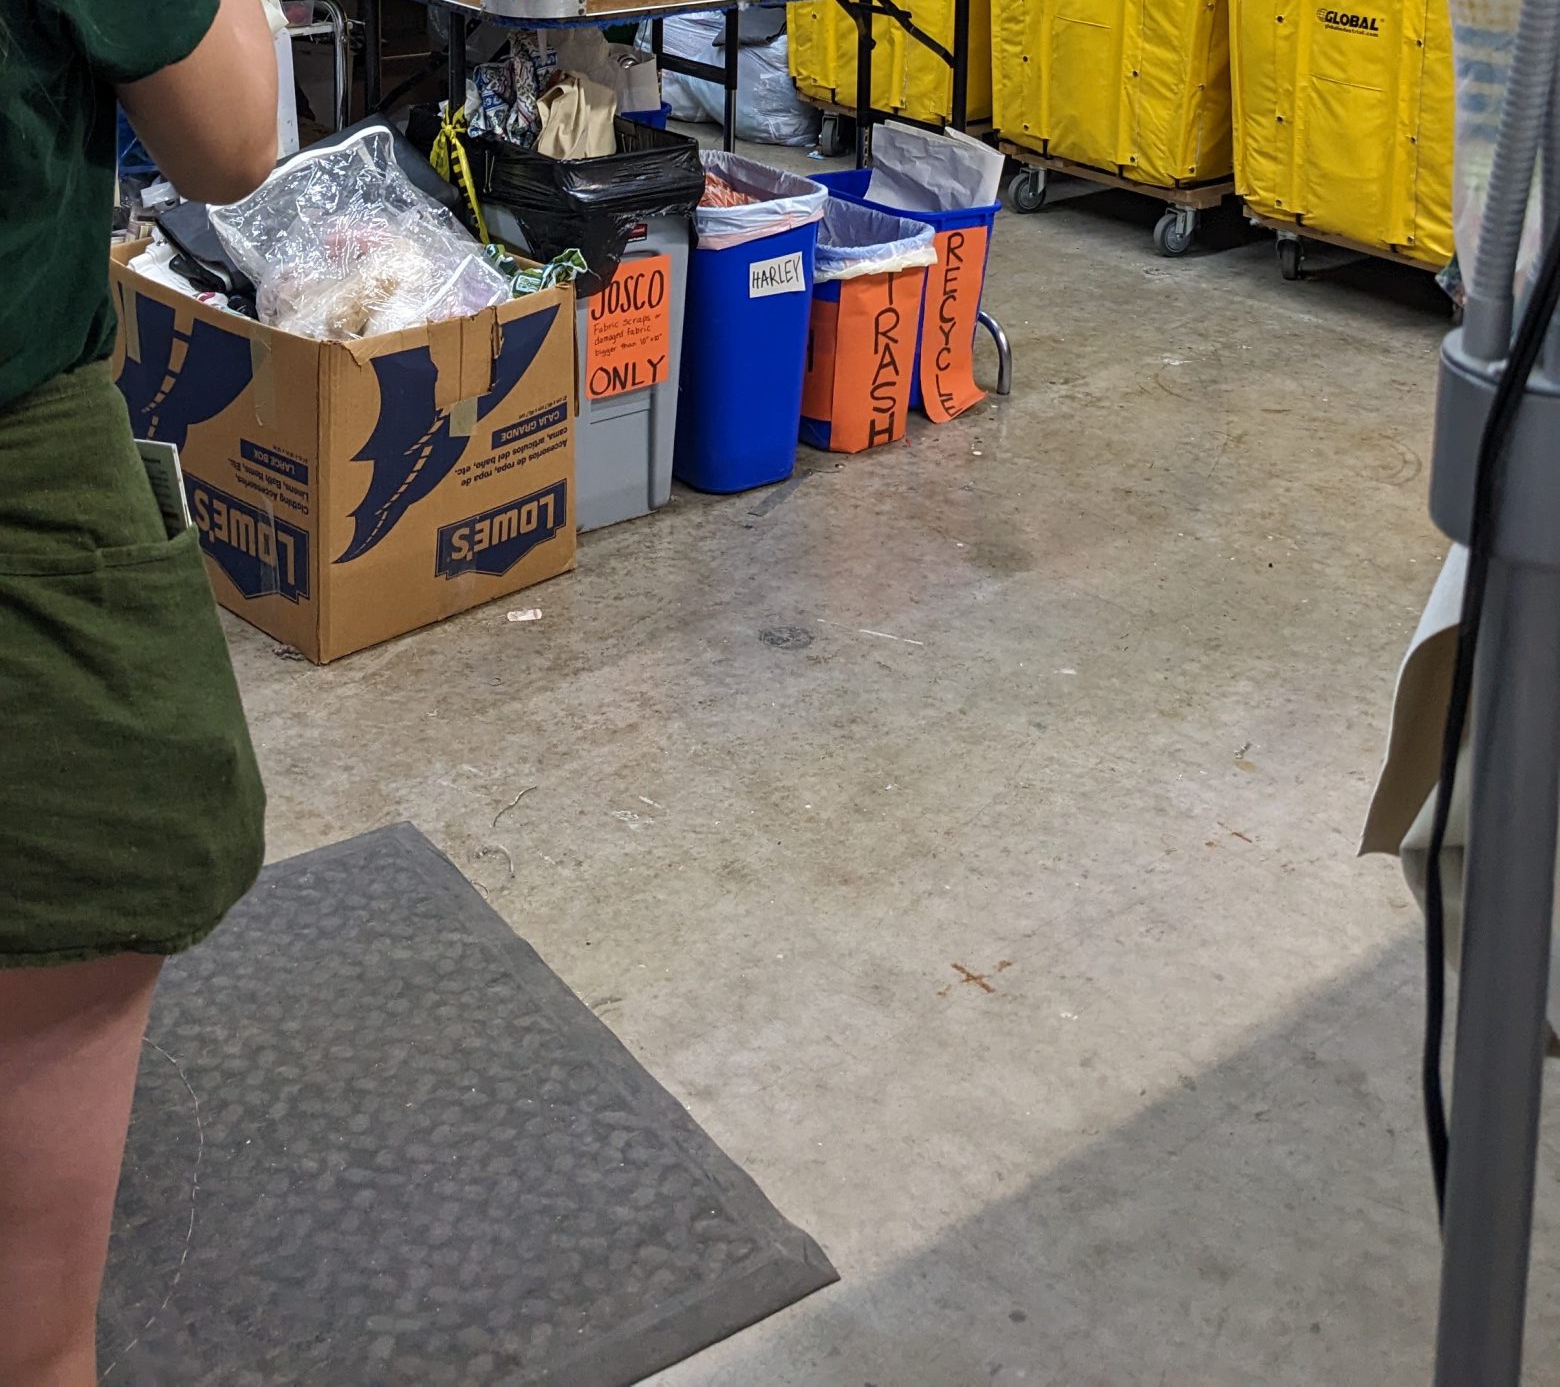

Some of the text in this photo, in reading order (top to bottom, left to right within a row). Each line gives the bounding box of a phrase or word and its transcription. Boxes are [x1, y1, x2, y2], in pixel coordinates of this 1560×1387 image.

[1325, 10, 1379, 32] GLOBAL
[752, 255, 801, 290] HARLEY
[591, 269, 665, 321] JOSCO
[593, 320, 619, 335] Fabric
[626, 325, 651, 337] fabric
[936, 232, 965, 418] RECYCLE
[589, 355, 666, 396] ONLY
[501, 411, 560, 442] CAJA GRANDE
[498, 451, 511, 463] del
[516, 457, 527, 466] de
[461, 477, 472, 487] de
[474, 470, 493, 483] ropa
[193, 488, 296, 586] LOWE'S
[451, 493, 555, 562] LOWE'S
